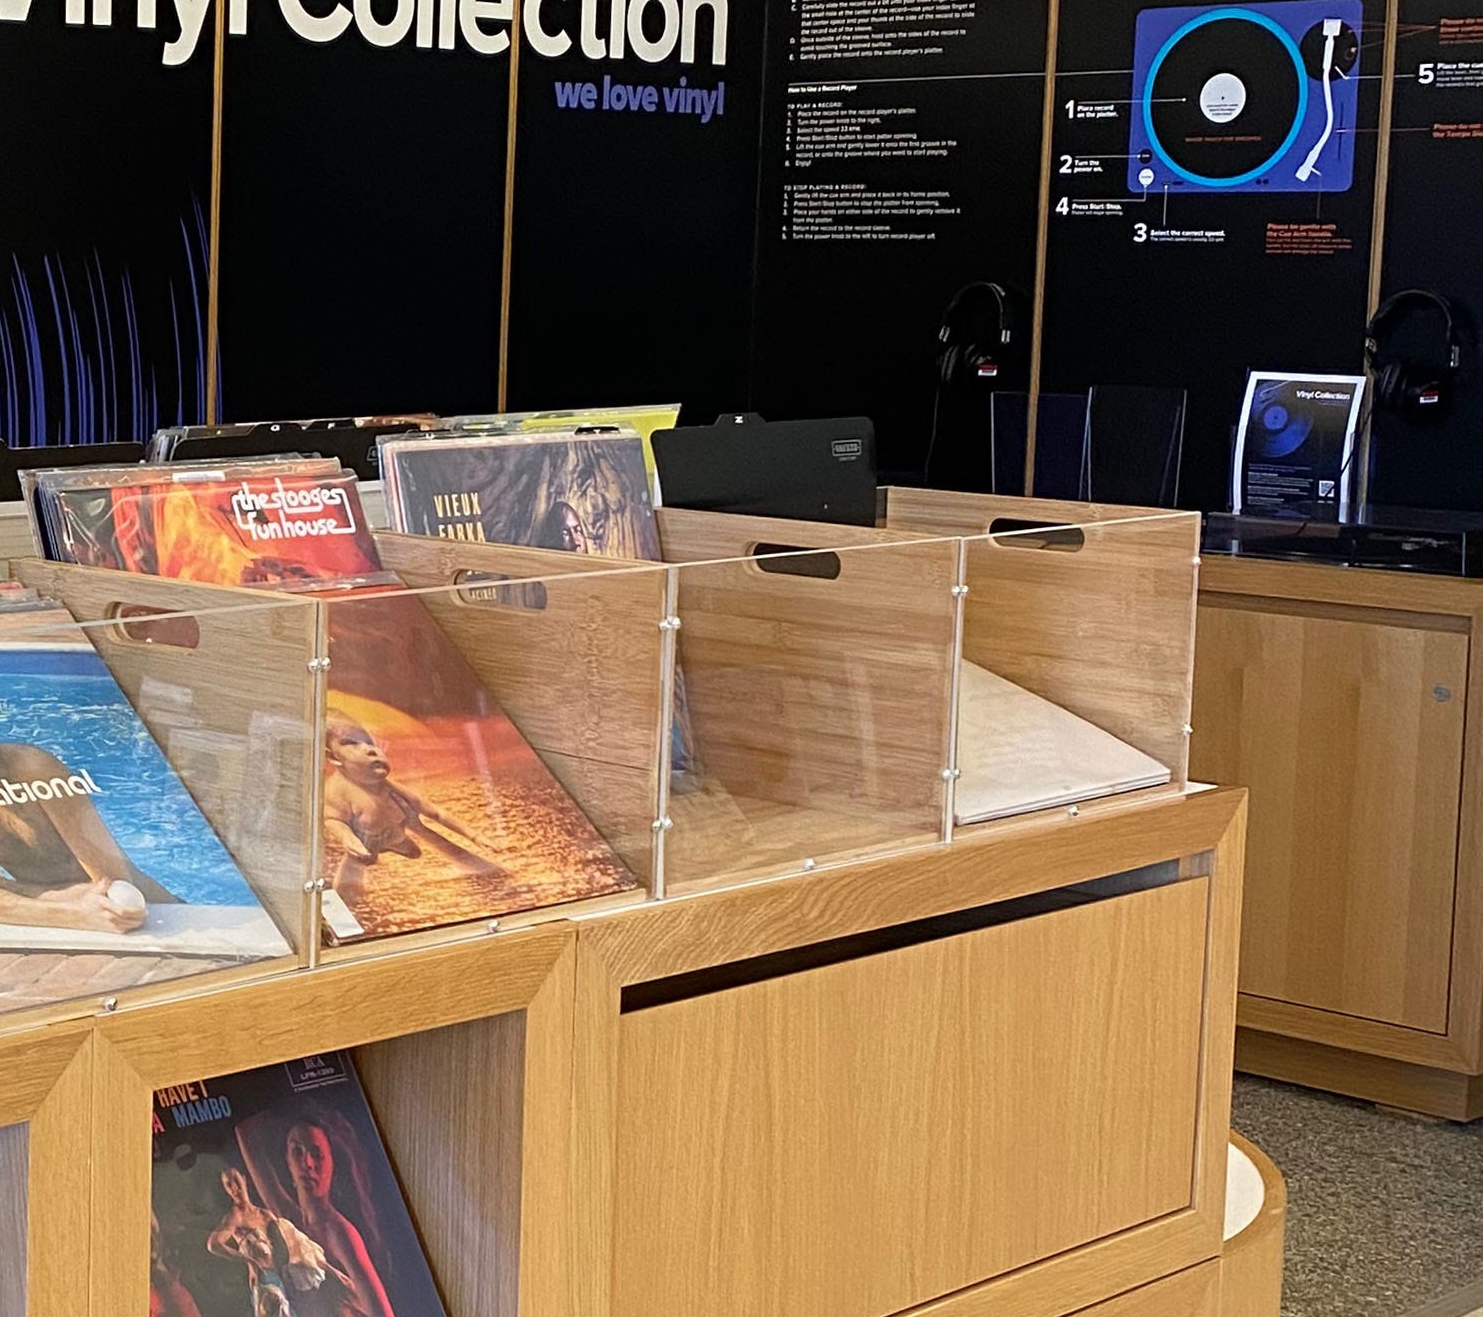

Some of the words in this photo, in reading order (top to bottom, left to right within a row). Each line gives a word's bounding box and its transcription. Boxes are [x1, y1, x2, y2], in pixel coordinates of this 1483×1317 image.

[1418, 64, 1434, 84] 5
[555, 82, 597, 109] we
[603, 75, 658, 112] love
[663, 76, 724, 123] vinyl
[1065, 100, 1074, 119] 1
[1059, 155, 1072, 173] 2
[1056, 197, 1069, 215] 4
[1133, 223, 1147, 242] 3
[1296, 391, 1315, 399] Vinyl
[1315, 391, 1350, 400] Collection
[434, 493, 481, 518] VIEUX
[157, 1082, 200, 1108] HAVE
[172, 1095, 232, 1128] MAMBO
